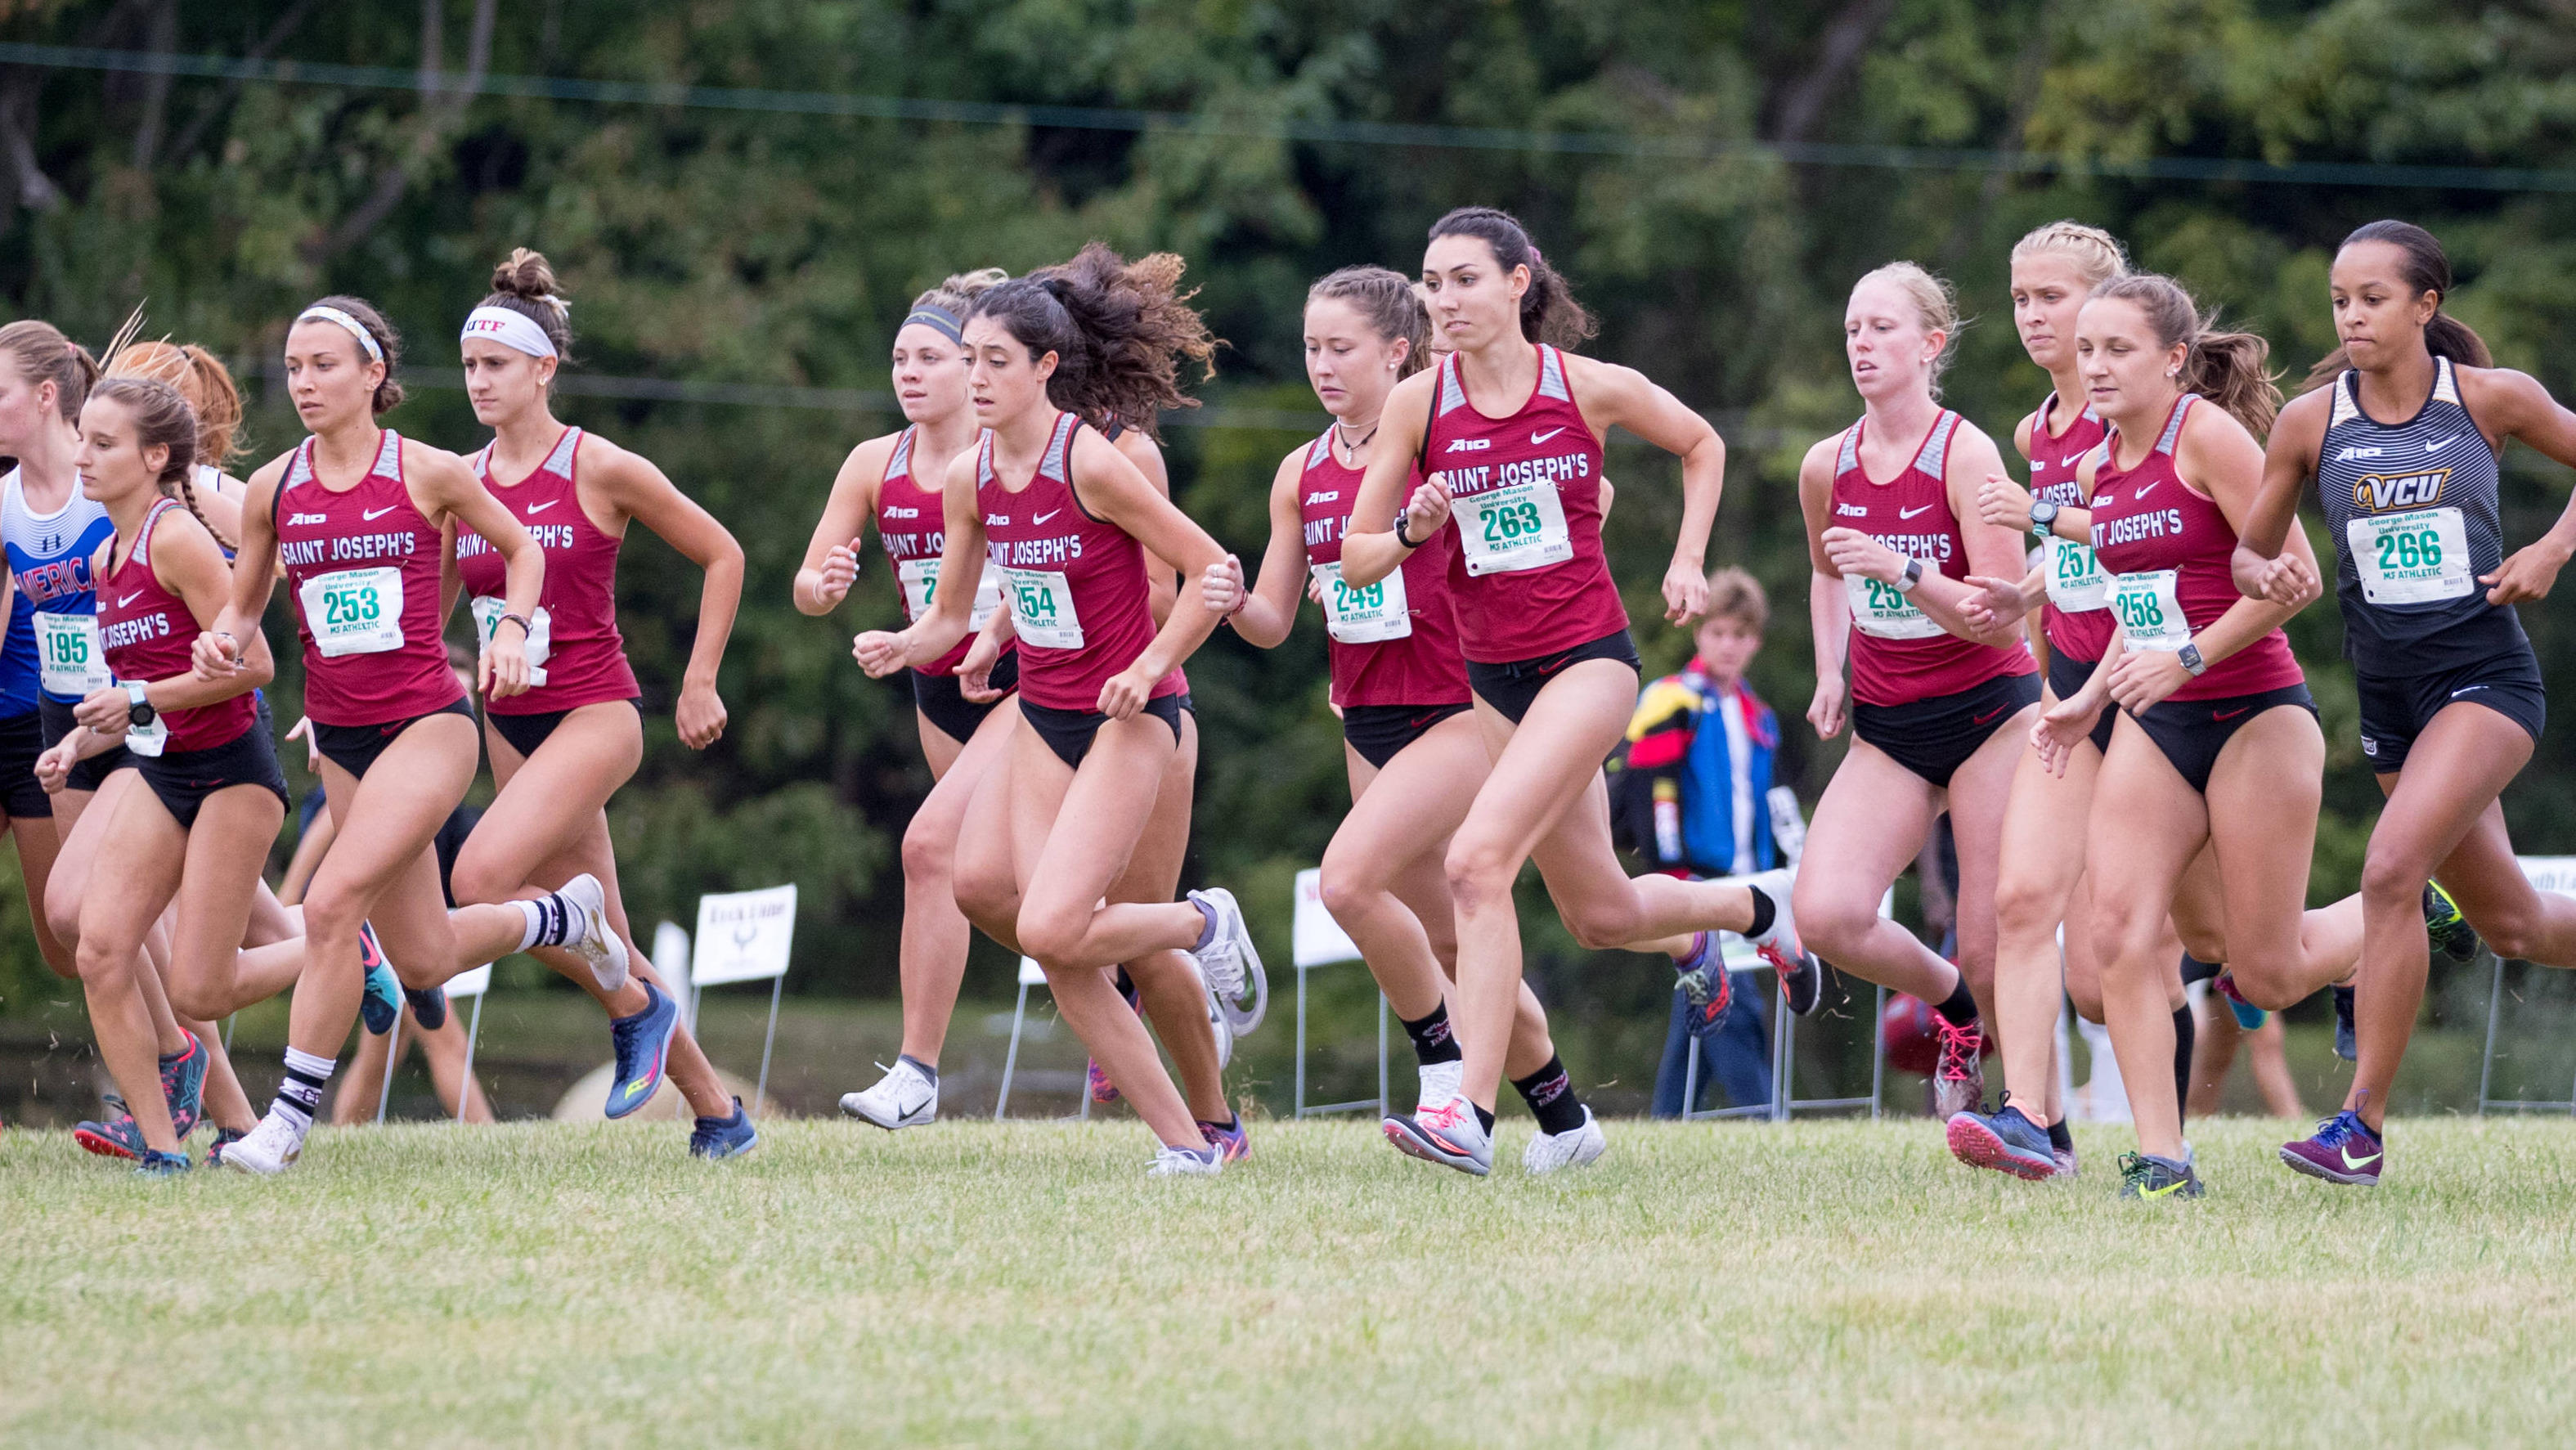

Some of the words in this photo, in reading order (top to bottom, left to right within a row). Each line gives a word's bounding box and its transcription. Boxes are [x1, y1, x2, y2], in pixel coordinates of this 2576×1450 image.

[464, 319, 505, 332] UTF
[1497, 453, 1588, 487] JOSEPH'S
[1470, 491, 1501, 504] George
[1503, 485, 1534, 496] Mason
[1480, 496, 1527, 510] University
[2354, 469, 2448, 512] VCU
[1479, 501, 1542, 542] 263
[2108, 509, 2183, 545] JOSEPH'S
[2367, 516, 2403, 527] George
[2404, 511, 2439, 523] Mason
[2379, 522, 2430, 535] University
[281, 539, 325, 565] SAINT
[331, 532, 415, 562] JOSEPH'S
[1012, 535, 1082, 565] JOSEPH'S
[1502, 535, 1543, 550] ATHLETIC
[2376, 530, 2442, 570] 266
[349, 569, 379, 580] Mason
[2057, 542, 2095, 579] 257
[2398, 568, 2443, 580] ATHLETIC
[1334, 579, 1384, 613] 249
[1865, 578, 1917, 609] 25
[2070, 576, 2103, 589] ATHLETIC
[324, 586, 380, 625] 253
[1351, 609, 1384, 622] ATHLETIC
[2116, 591, 2164, 628] 258
[342, 621, 380, 633] ATHLETIC
[47, 632, 88, 664] 195
